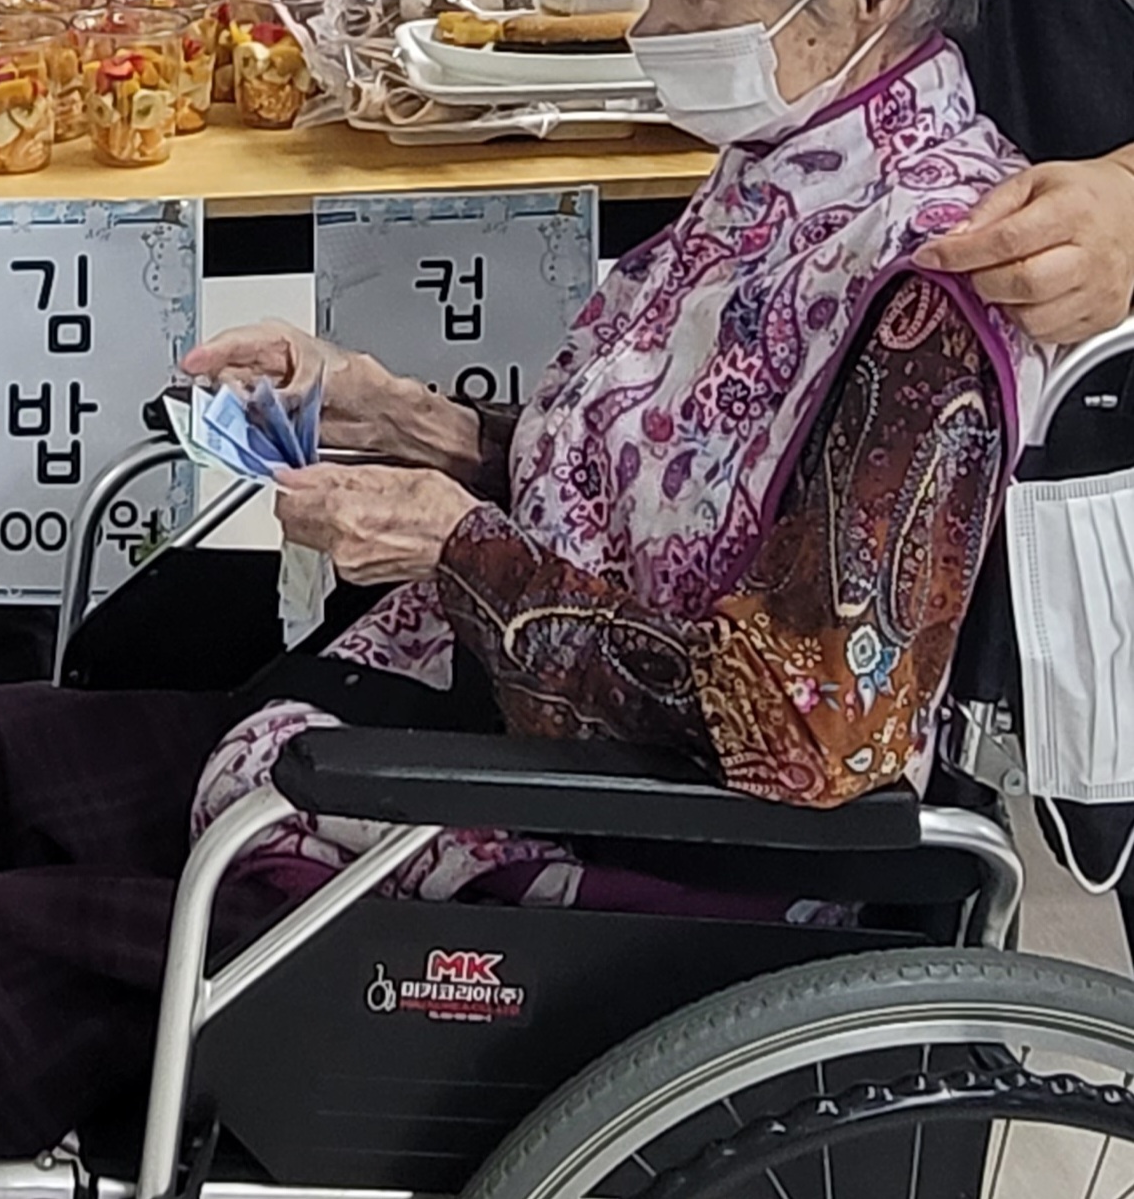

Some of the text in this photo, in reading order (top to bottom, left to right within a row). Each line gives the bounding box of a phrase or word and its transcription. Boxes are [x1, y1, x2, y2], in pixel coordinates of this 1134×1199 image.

[9, 254, 91, 354] 김
[414, 256, 484, 342] 컵
[7, 381, 99, 485] 밥
[426, 950, 504, 985] MK
